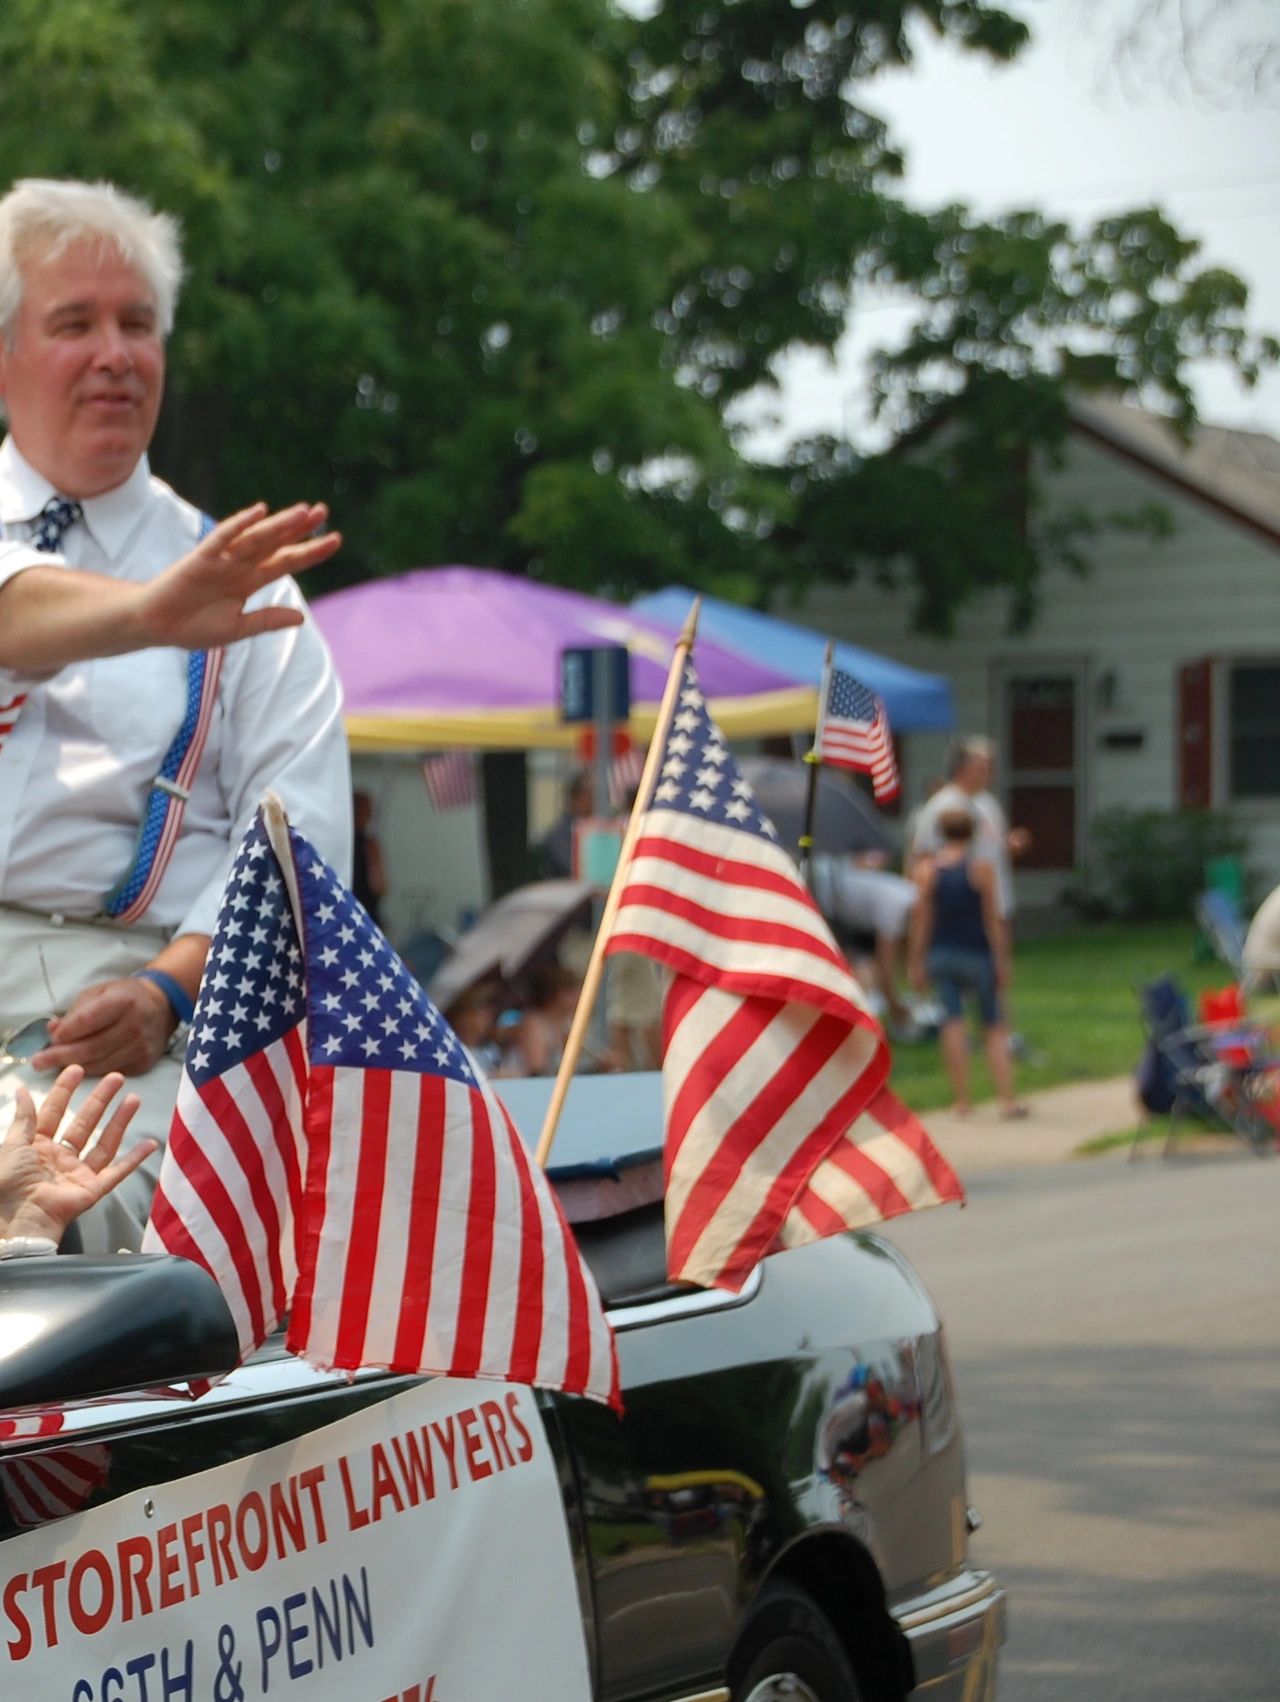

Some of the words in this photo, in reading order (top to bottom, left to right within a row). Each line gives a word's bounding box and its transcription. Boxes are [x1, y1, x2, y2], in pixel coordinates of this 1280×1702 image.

[2, 1464, 327, 1662] STOREFRONT
[338, 1391, 534, 1532] LAWYERS
[72, 1638, 194, 1702] TH
[214, 1623, 245, 1702] &
[256, 1566, 374, 1694] PENN
